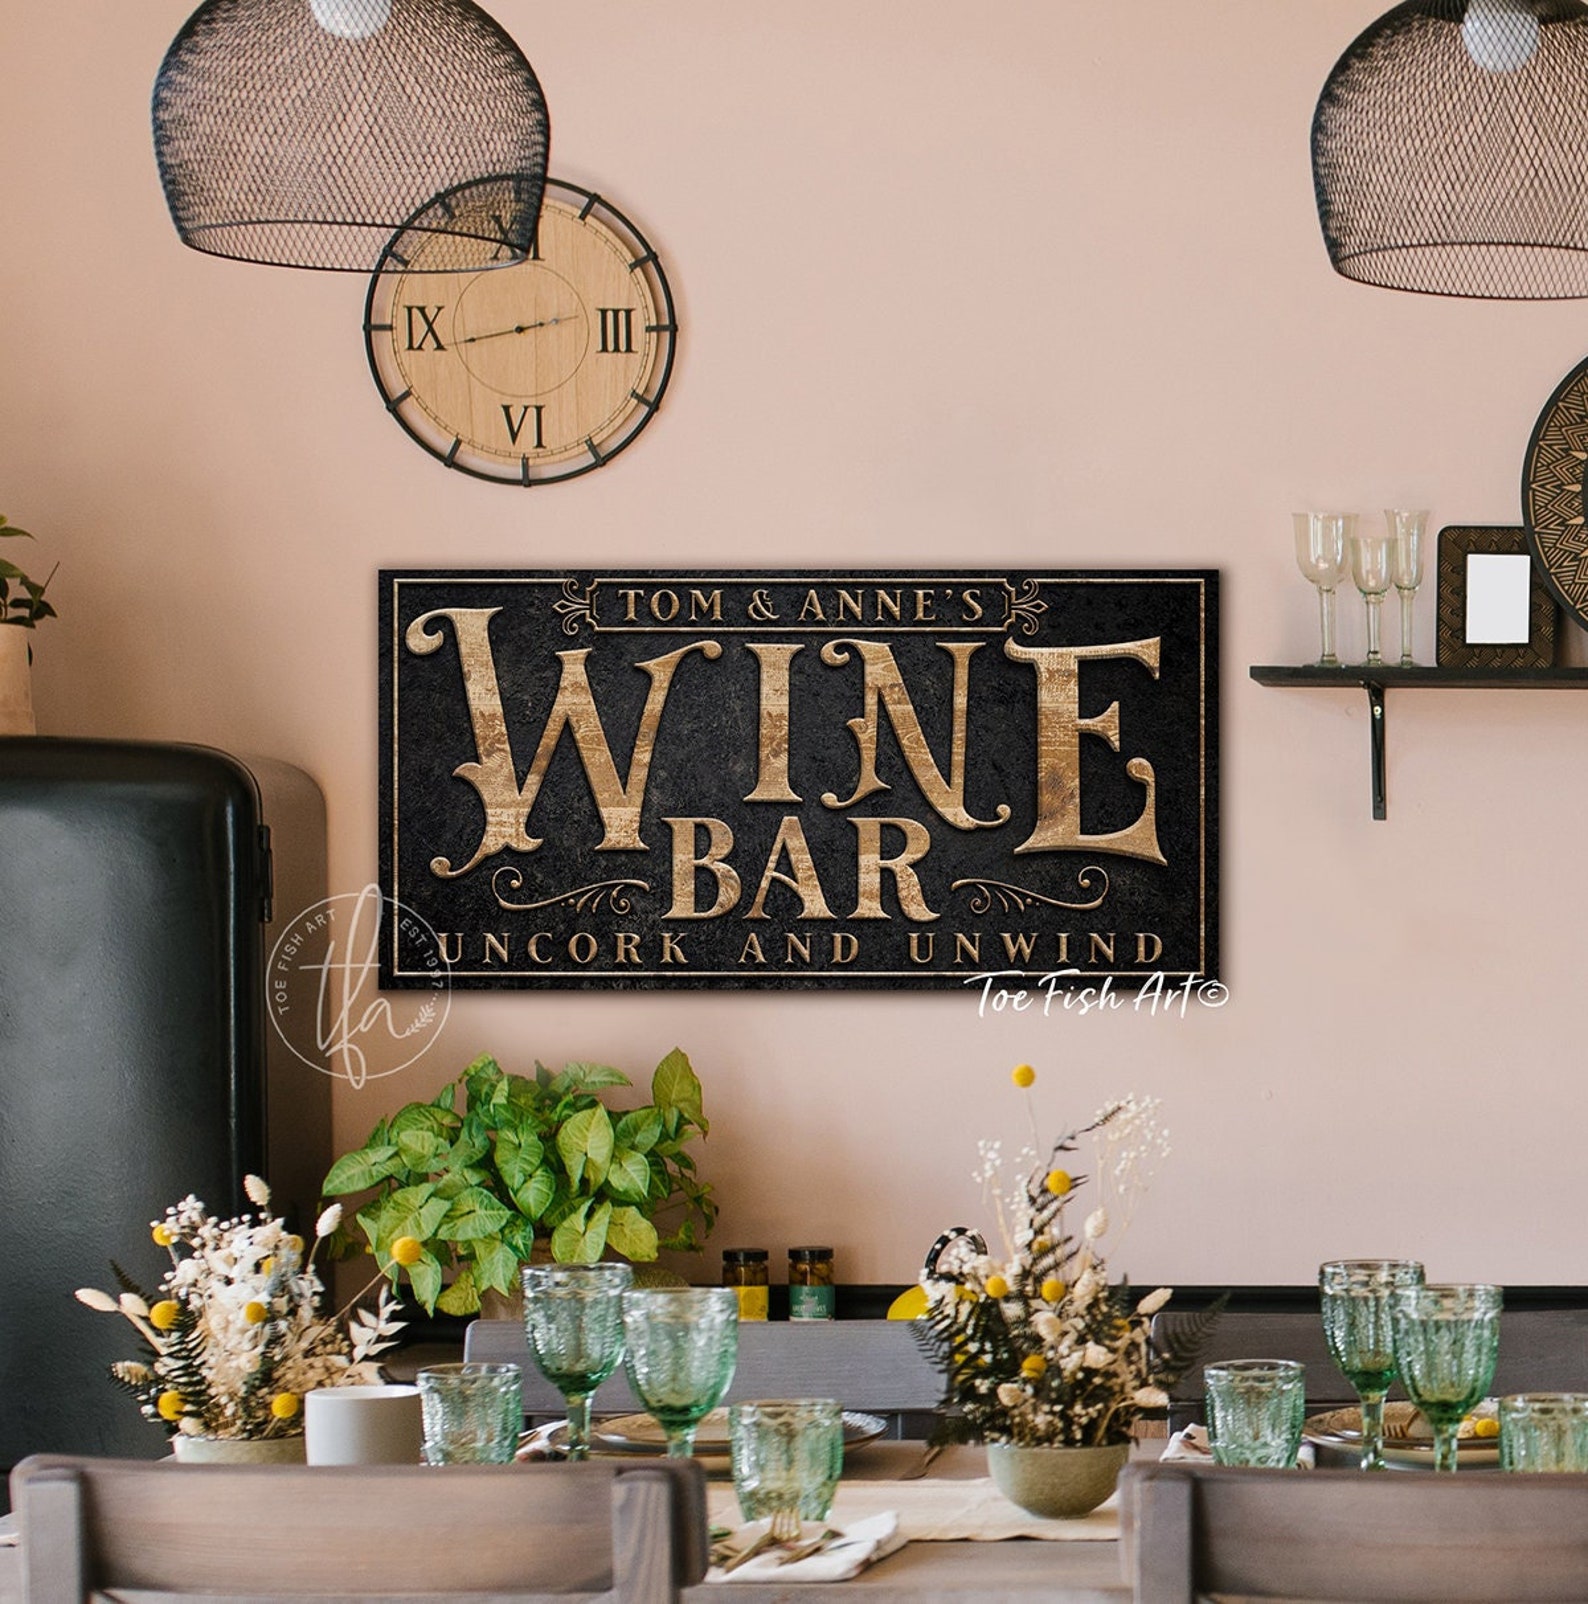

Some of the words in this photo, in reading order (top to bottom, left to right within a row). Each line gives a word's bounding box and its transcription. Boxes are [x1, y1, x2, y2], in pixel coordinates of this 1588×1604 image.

[403, 305, 447, 351] IX
[596, 308, 638, 354] III
[501, 404, 546, 449] VI
[618, 588, 724, 621] TOM
[747, 588, 781, 621] &
[798, 588, 985, 621] ANNE'S
[405, 606, 1168, 879] WINE
[662, 815, 940, 923] BAR
[438, 932, 689, 964] UNCORK
[737, 932, 860, 964] AND
[908, 932, 1164, 964] UNWIND
